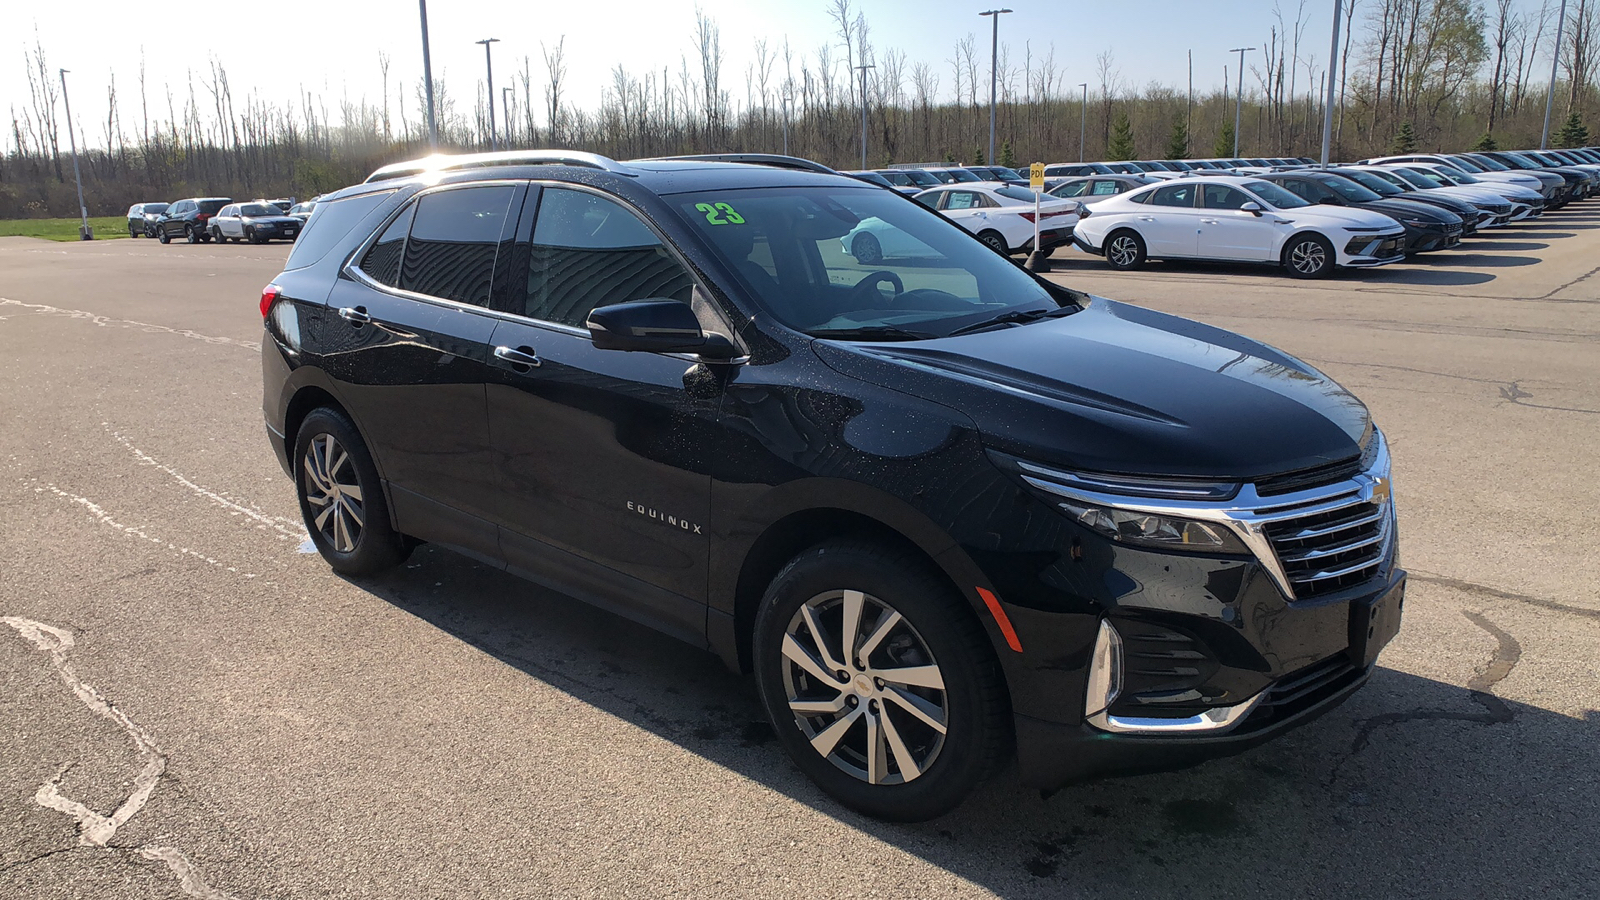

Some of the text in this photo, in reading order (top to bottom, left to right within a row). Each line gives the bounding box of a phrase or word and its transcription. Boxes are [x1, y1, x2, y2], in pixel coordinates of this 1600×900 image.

[1031, 170, 1042, 178] PDI
[695, 202, 746, 225] 23
[626, 500, 702, 535] EQUINOX
